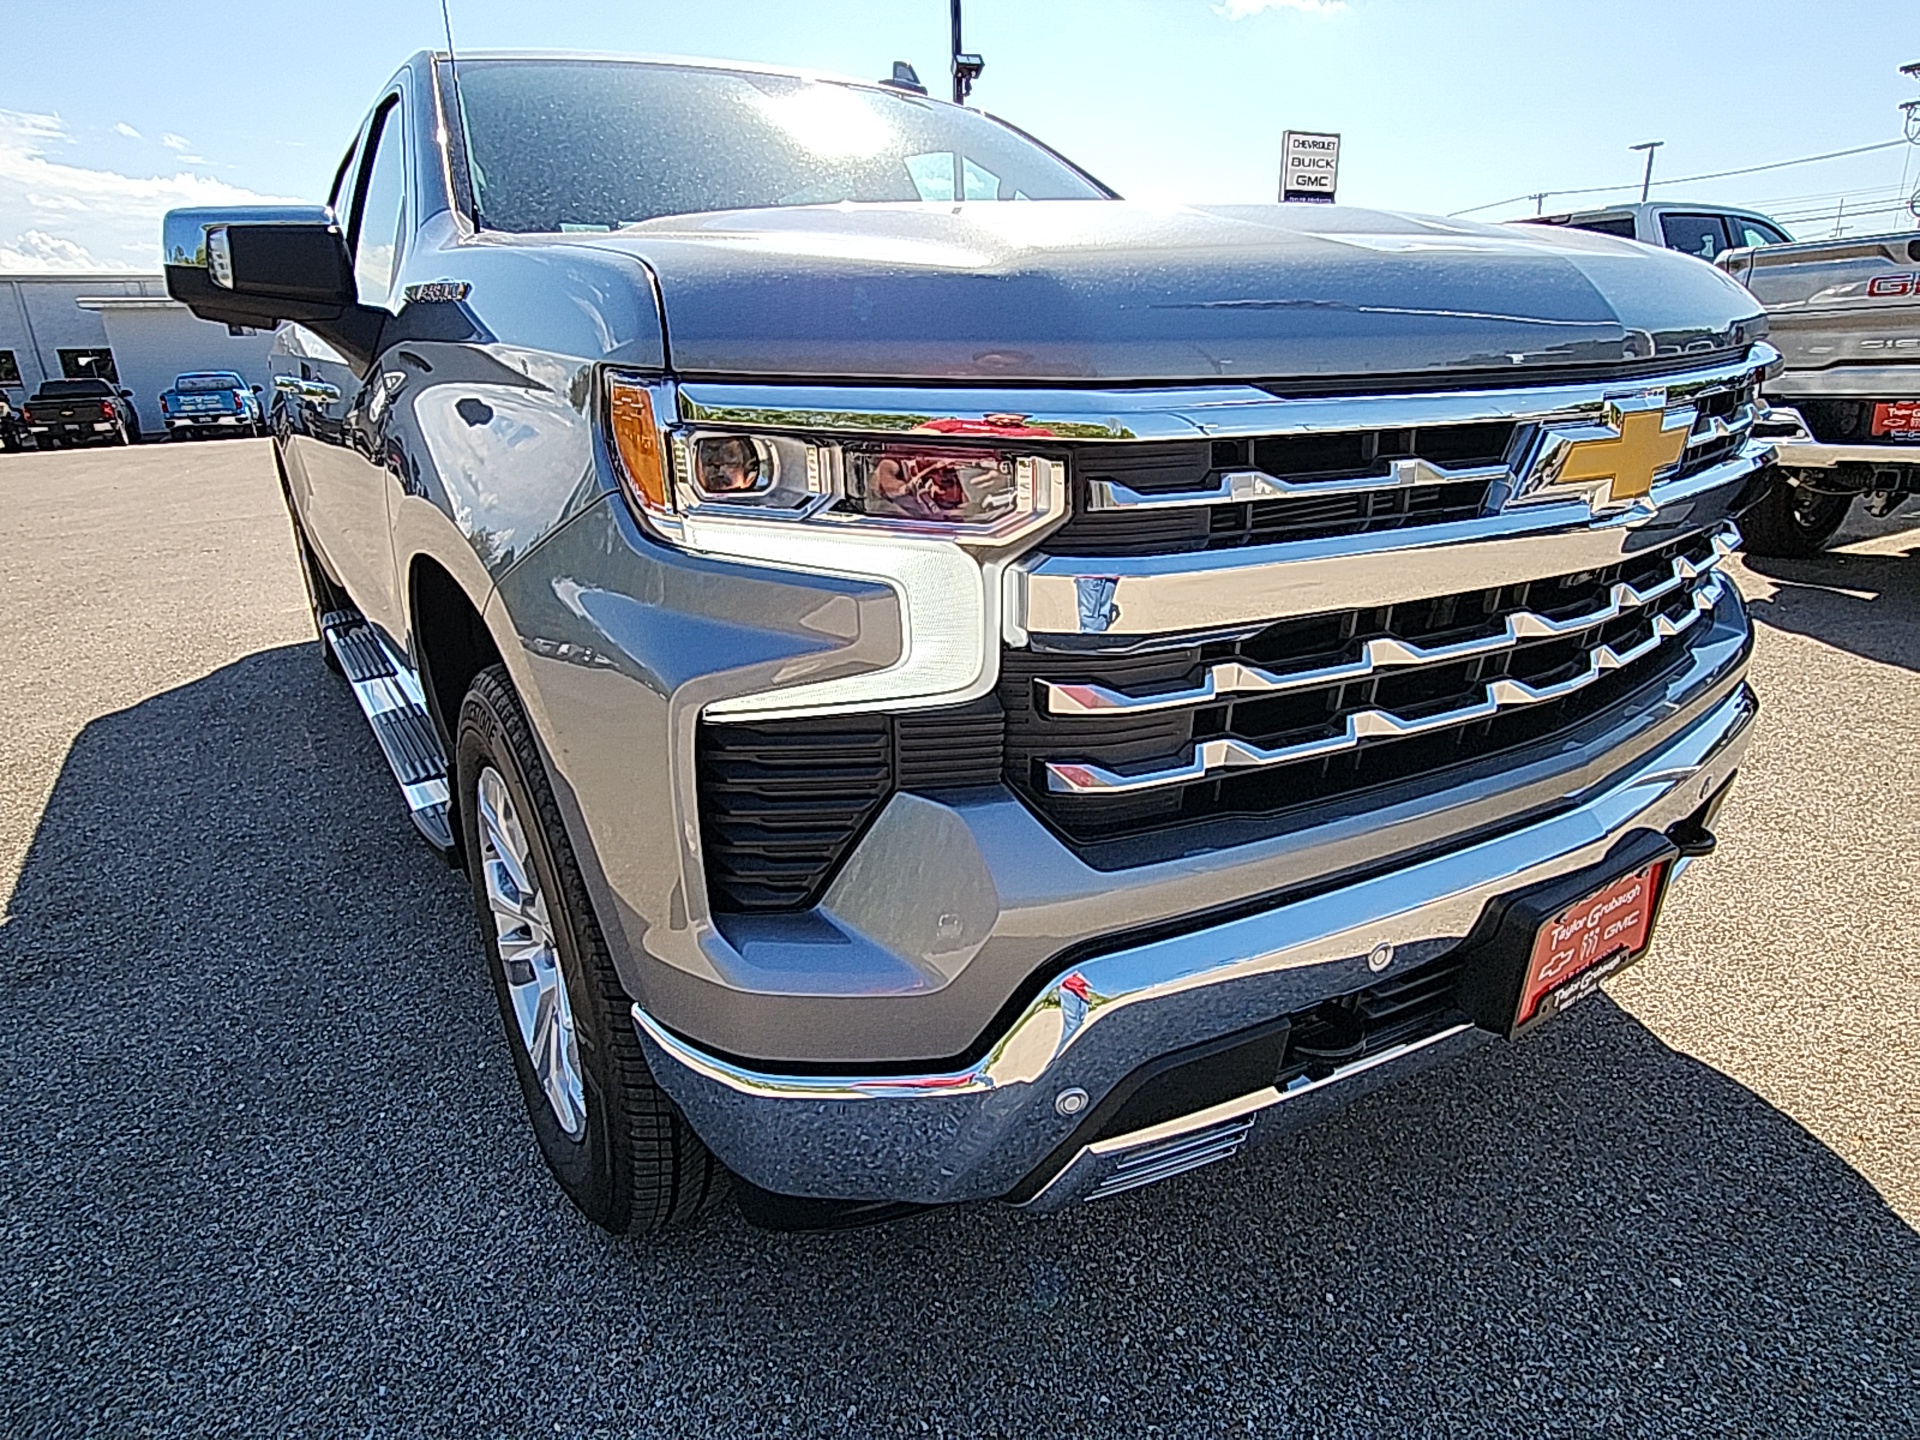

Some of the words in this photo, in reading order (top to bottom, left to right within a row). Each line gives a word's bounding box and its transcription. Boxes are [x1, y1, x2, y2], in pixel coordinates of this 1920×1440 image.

[1293, 139, 1336, 150] CHEVROLET
[1291, 157, 1335, 169] BUICK
[1296, 175, 1329, 187] GMC
[1866, 274, 1920, 297] G
[1551, 916, 1587, 950] Taylor
[1587, 884, 1641, 928] Grubaugh
[1603, 910, 1640, 940] GMC
